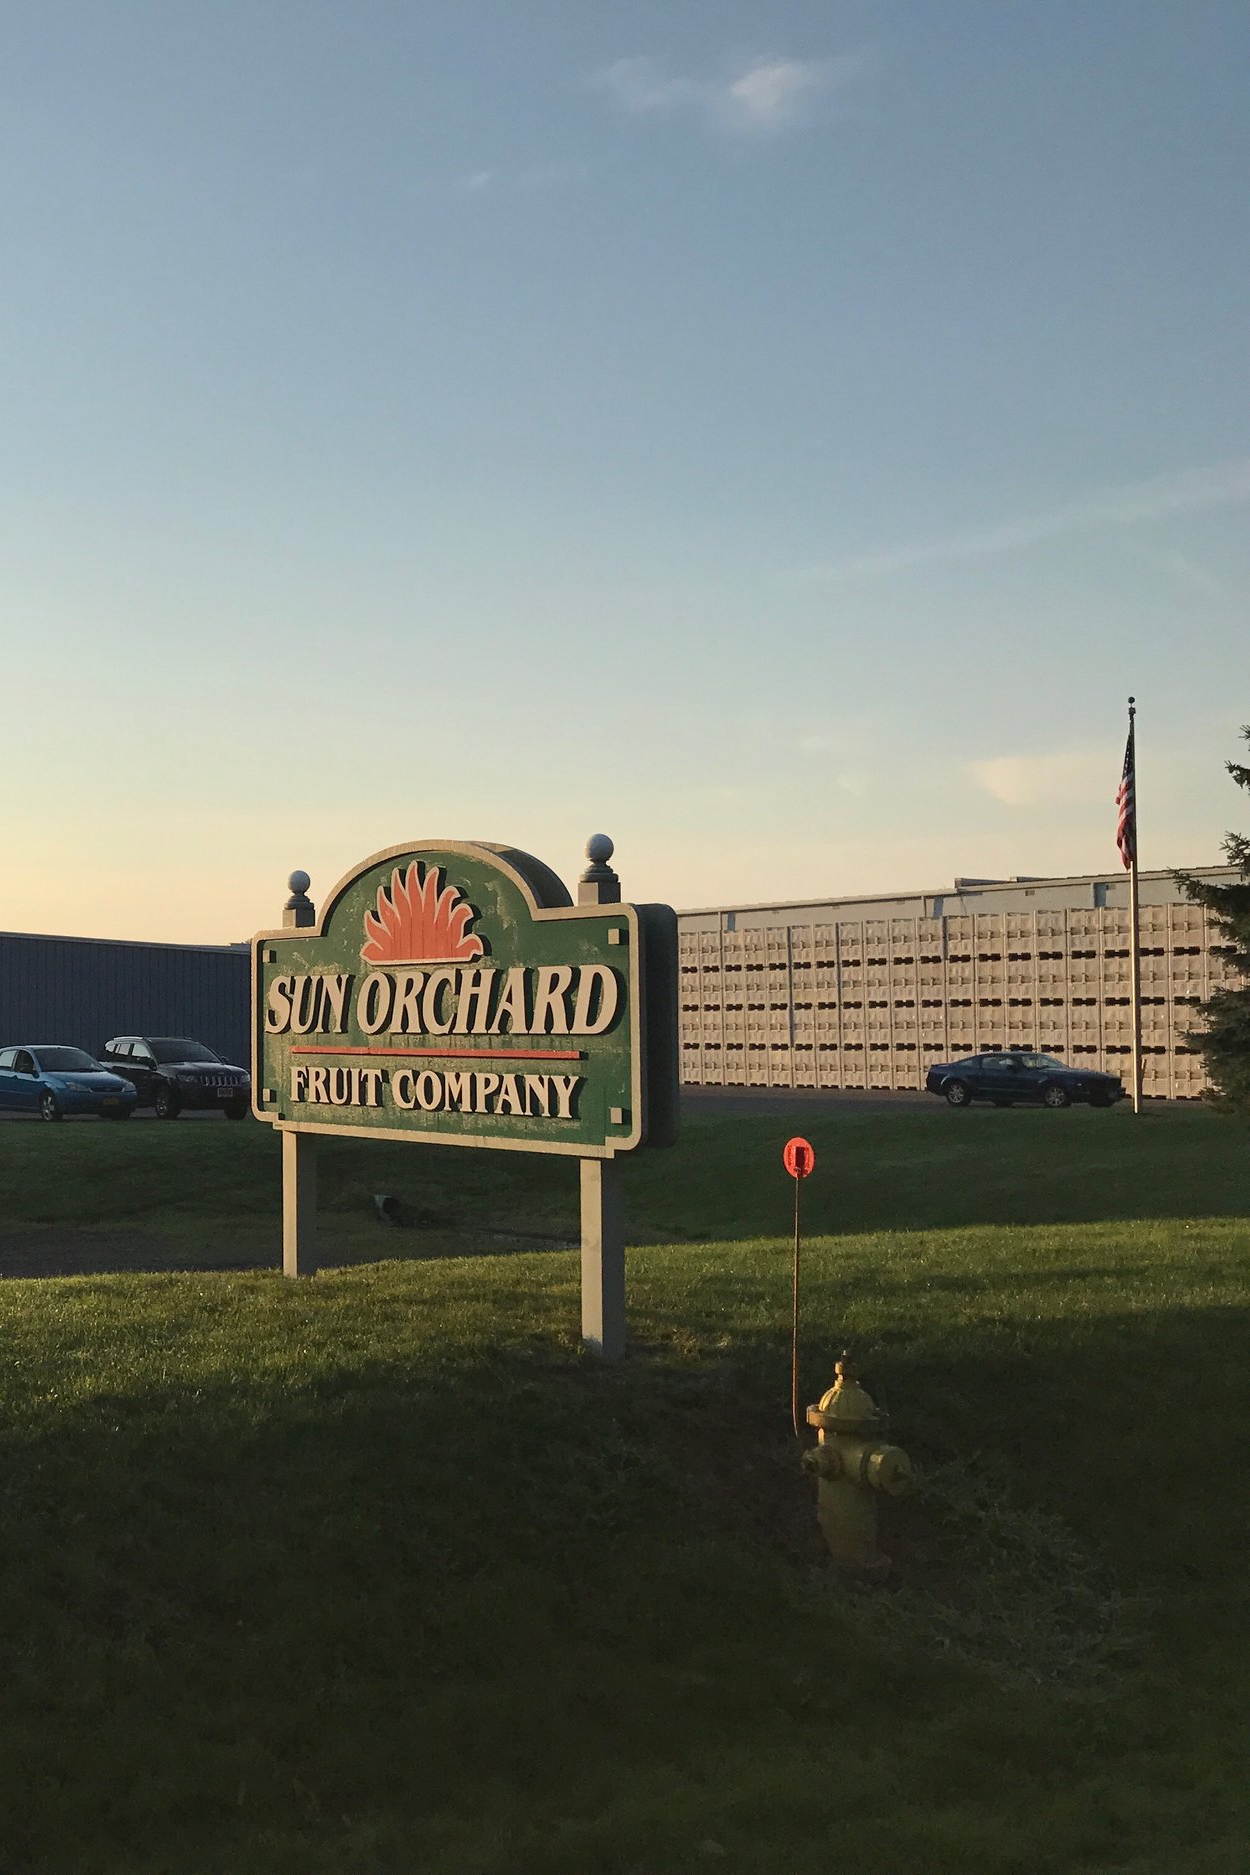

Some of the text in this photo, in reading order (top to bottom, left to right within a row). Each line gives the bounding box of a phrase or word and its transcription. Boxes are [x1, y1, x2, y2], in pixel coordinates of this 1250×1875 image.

[265, 964, 618, 1035] SUN ORCHARD
[290, 1066, 580, 1118] FRUIT COMPANY
